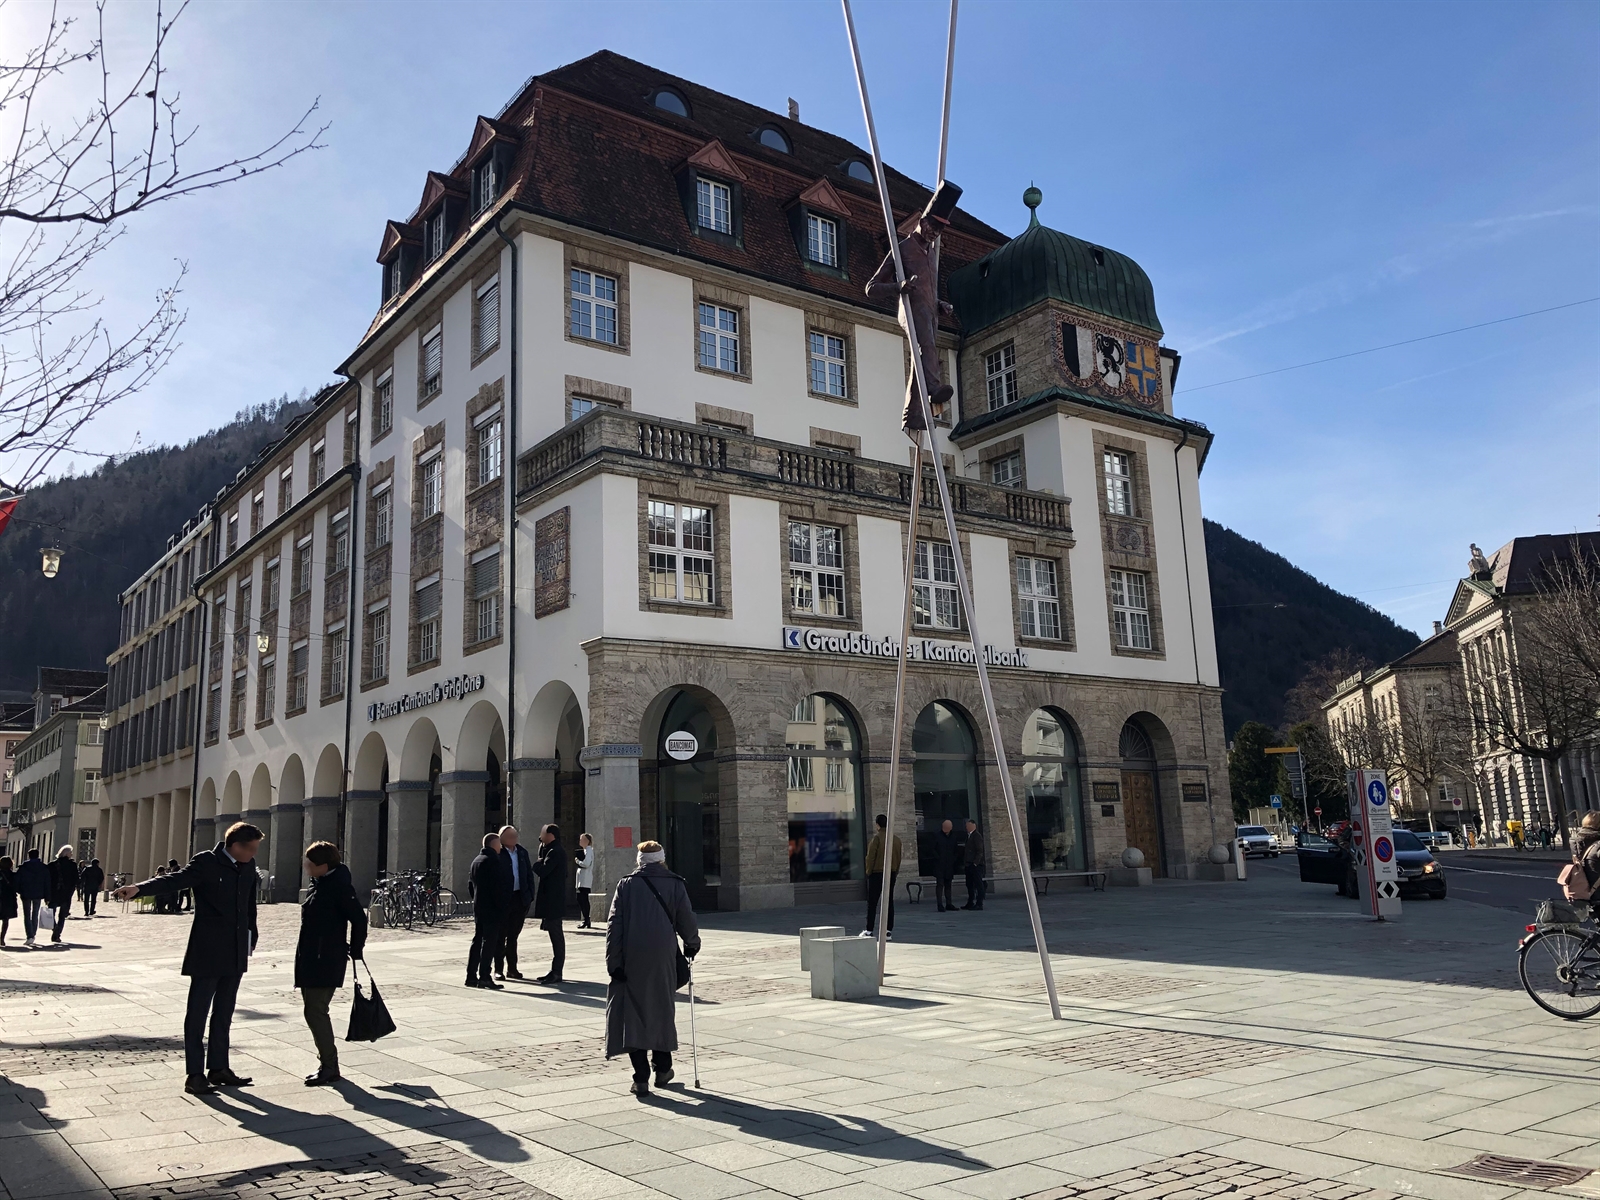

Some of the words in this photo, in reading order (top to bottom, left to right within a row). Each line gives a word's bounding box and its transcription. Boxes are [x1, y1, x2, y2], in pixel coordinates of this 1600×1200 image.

[805, 629, 919, 659] Graubündner
[376, 701, 399, 719] Banca
[400, 682, 441, 713] Cantonale
[442, 674, 484, 700] Grigione
[670, 741, 693, 750] BANCOMAT
